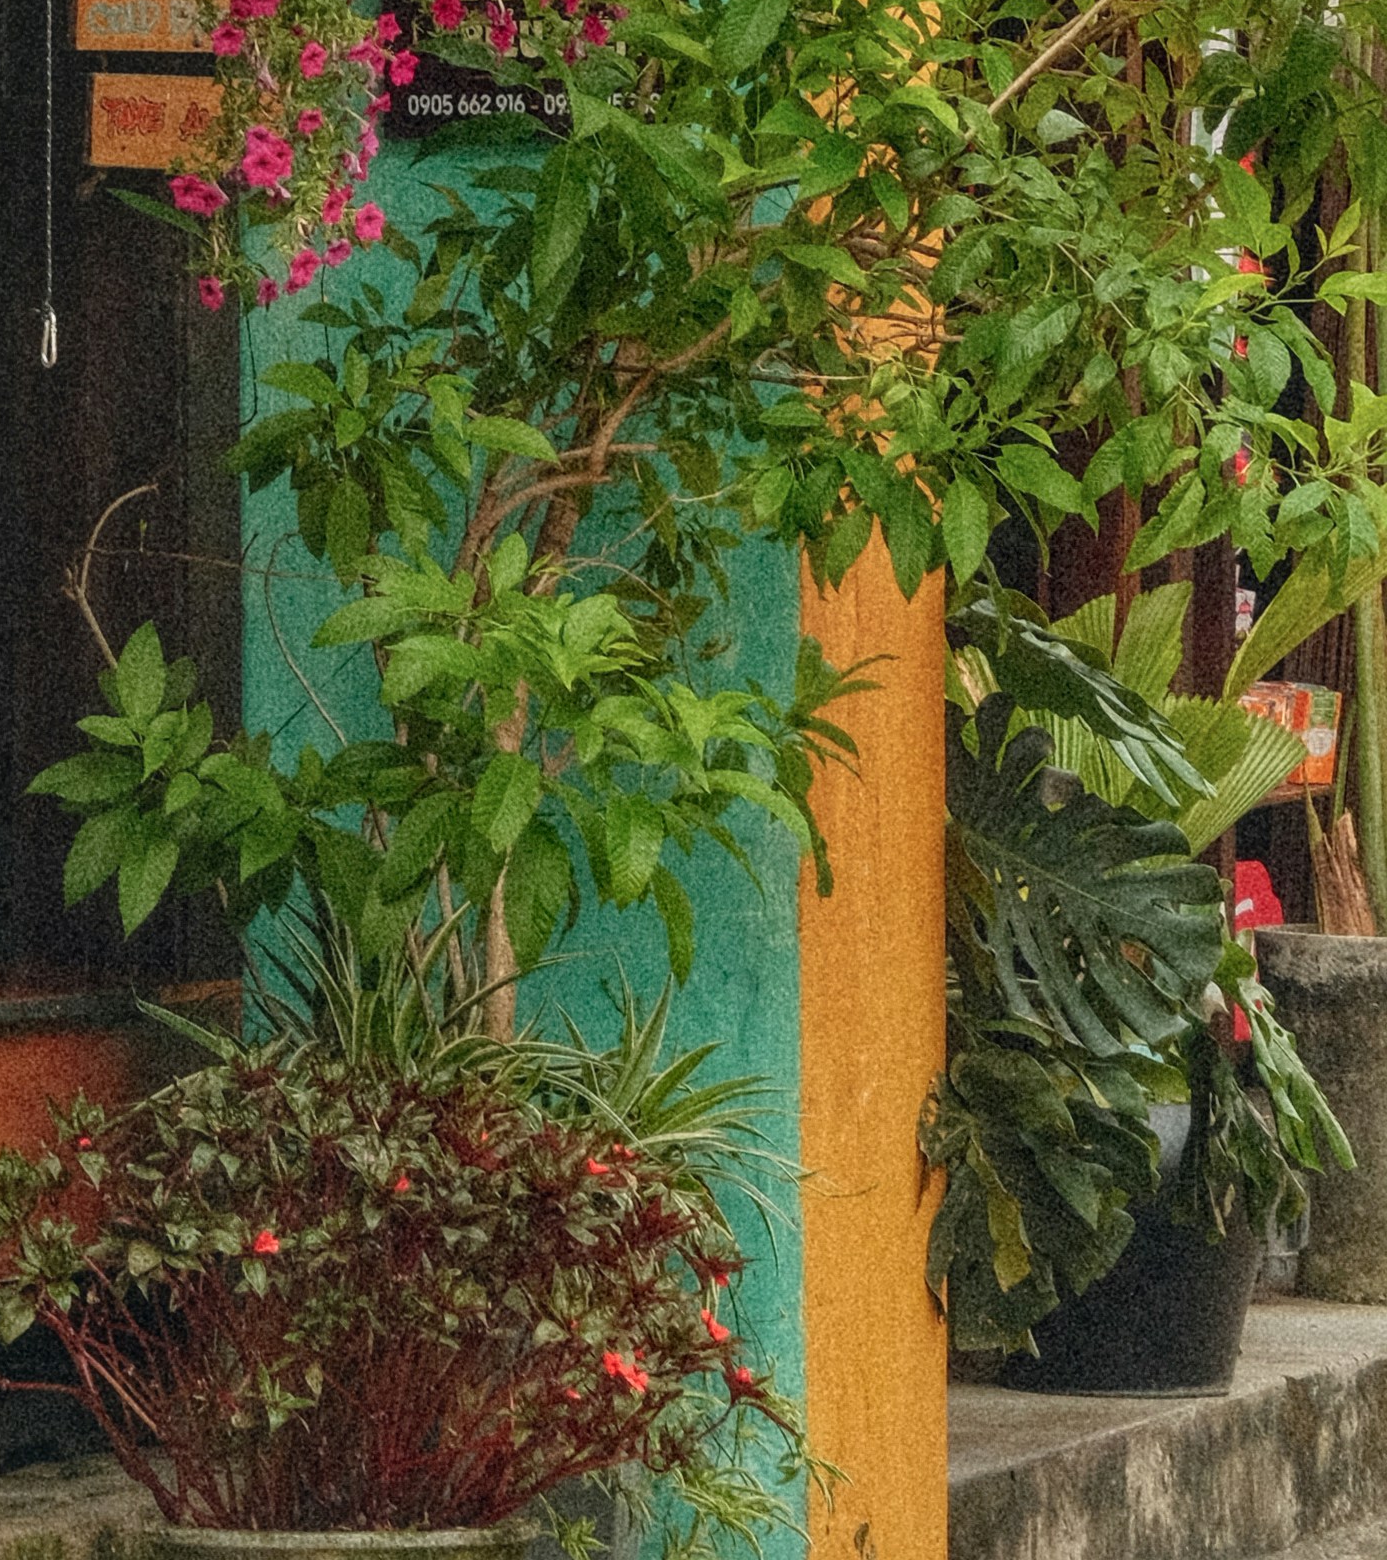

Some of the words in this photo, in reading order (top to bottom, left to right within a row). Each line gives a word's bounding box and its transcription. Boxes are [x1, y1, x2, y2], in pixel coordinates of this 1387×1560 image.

[407, 93, 453, 117] 0905
[457, 93, 492, 116] 662
[495, 92, 526, 115] 916
